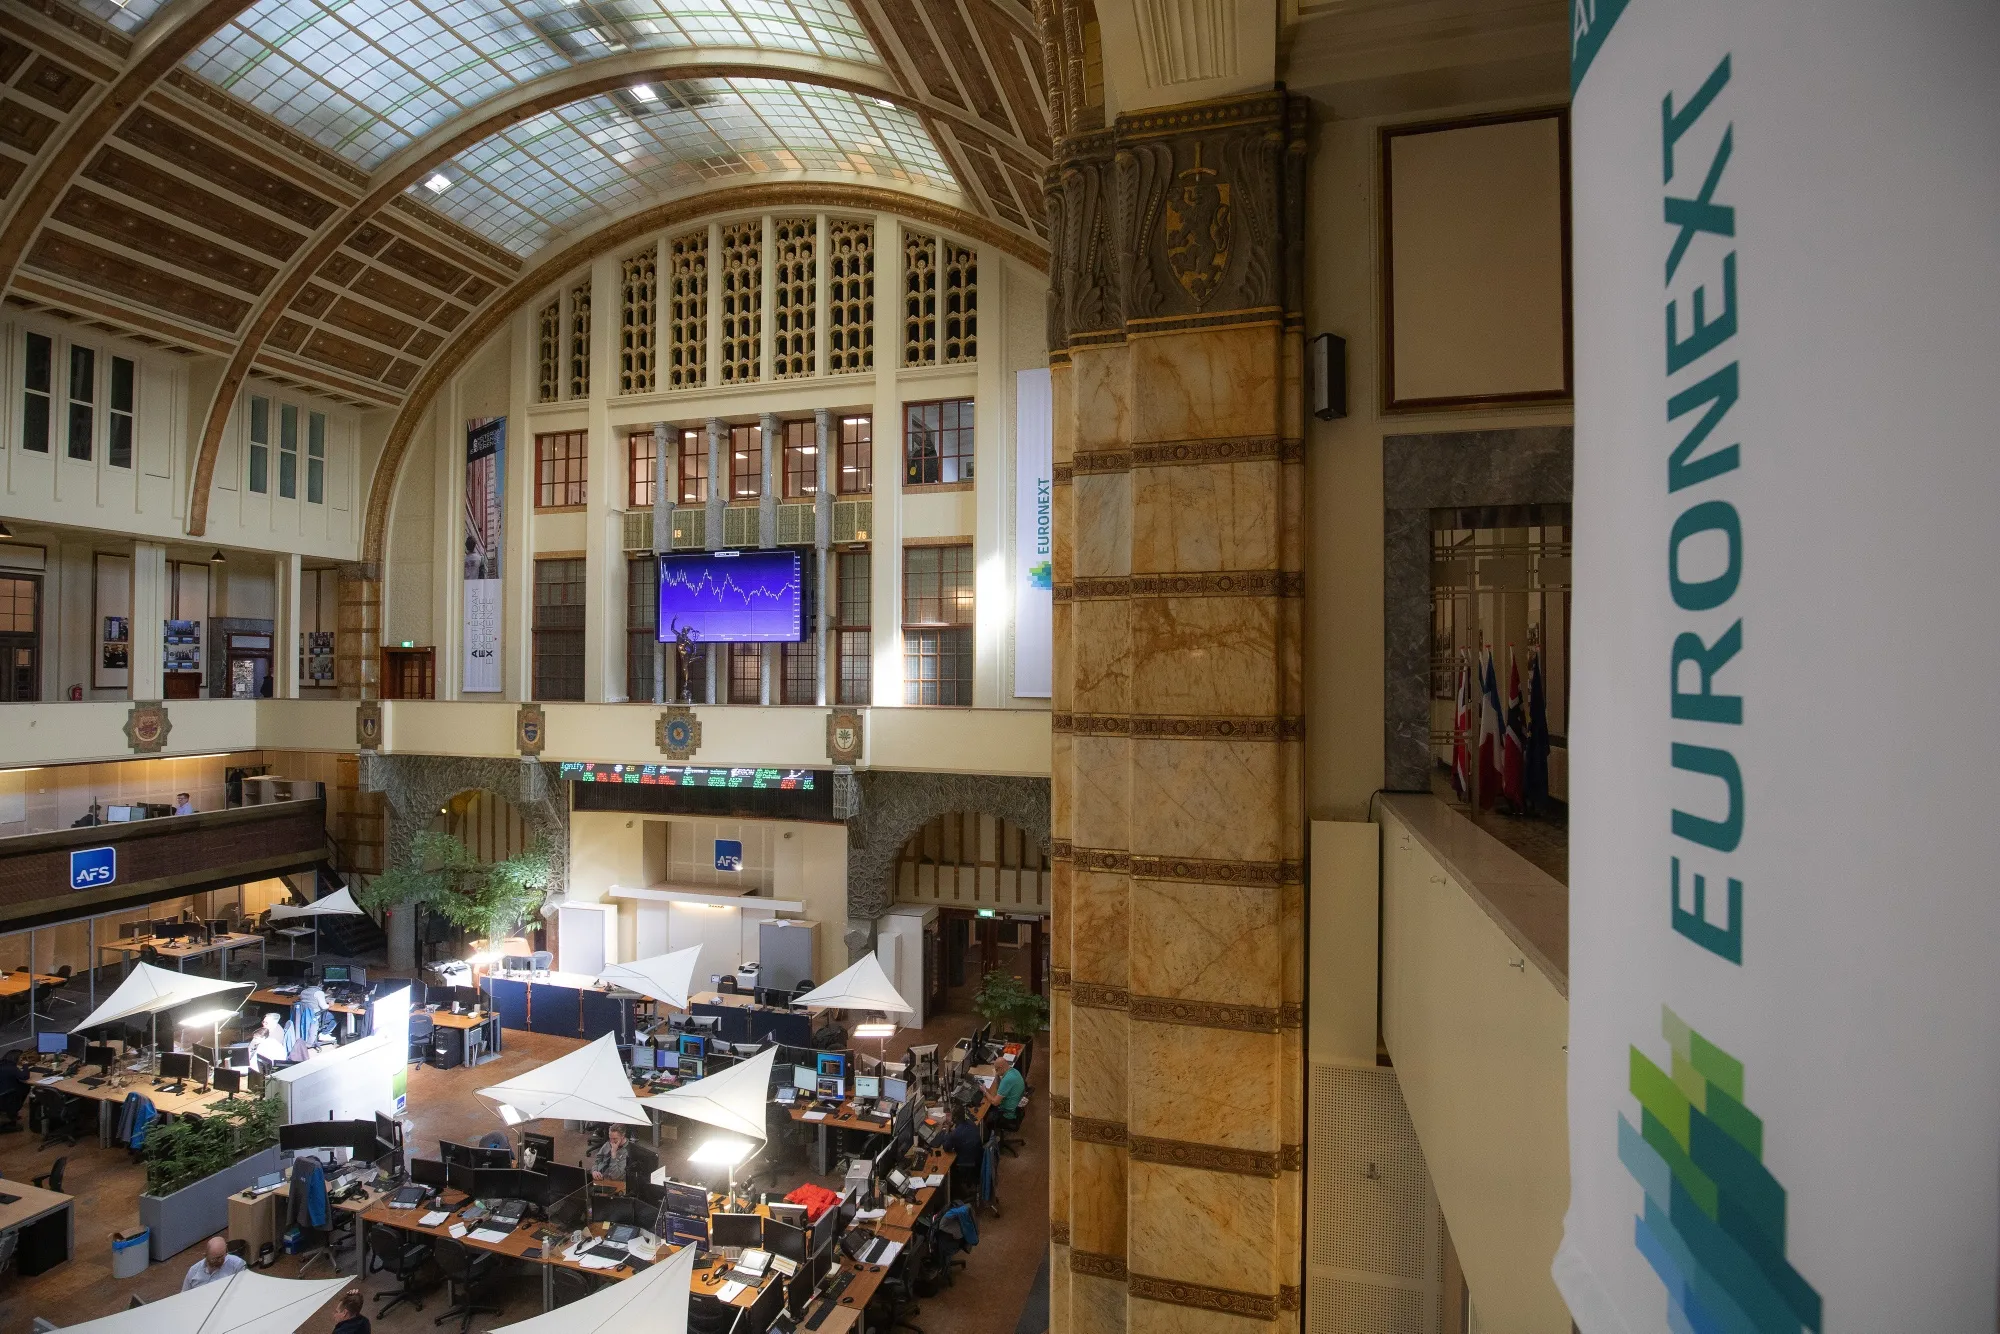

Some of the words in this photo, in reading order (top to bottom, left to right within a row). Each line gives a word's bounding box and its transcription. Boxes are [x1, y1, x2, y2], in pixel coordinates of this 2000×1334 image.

[674, 529, 682, 538] 19
[858, 531, 866, 540] 76
[1037, 478, 1050, 555] EURONEXT
[1661, 51, 1745, 966] EURONEXT
[471, 588, 479, 658] AMSTERDAM
[478, 598, 486, 658] EXCHANGE
[485, 597, 494, 665] EXPERIENCE
[76, 866, 110, 883] AFS
[717, 855, 739, 867] AFS
